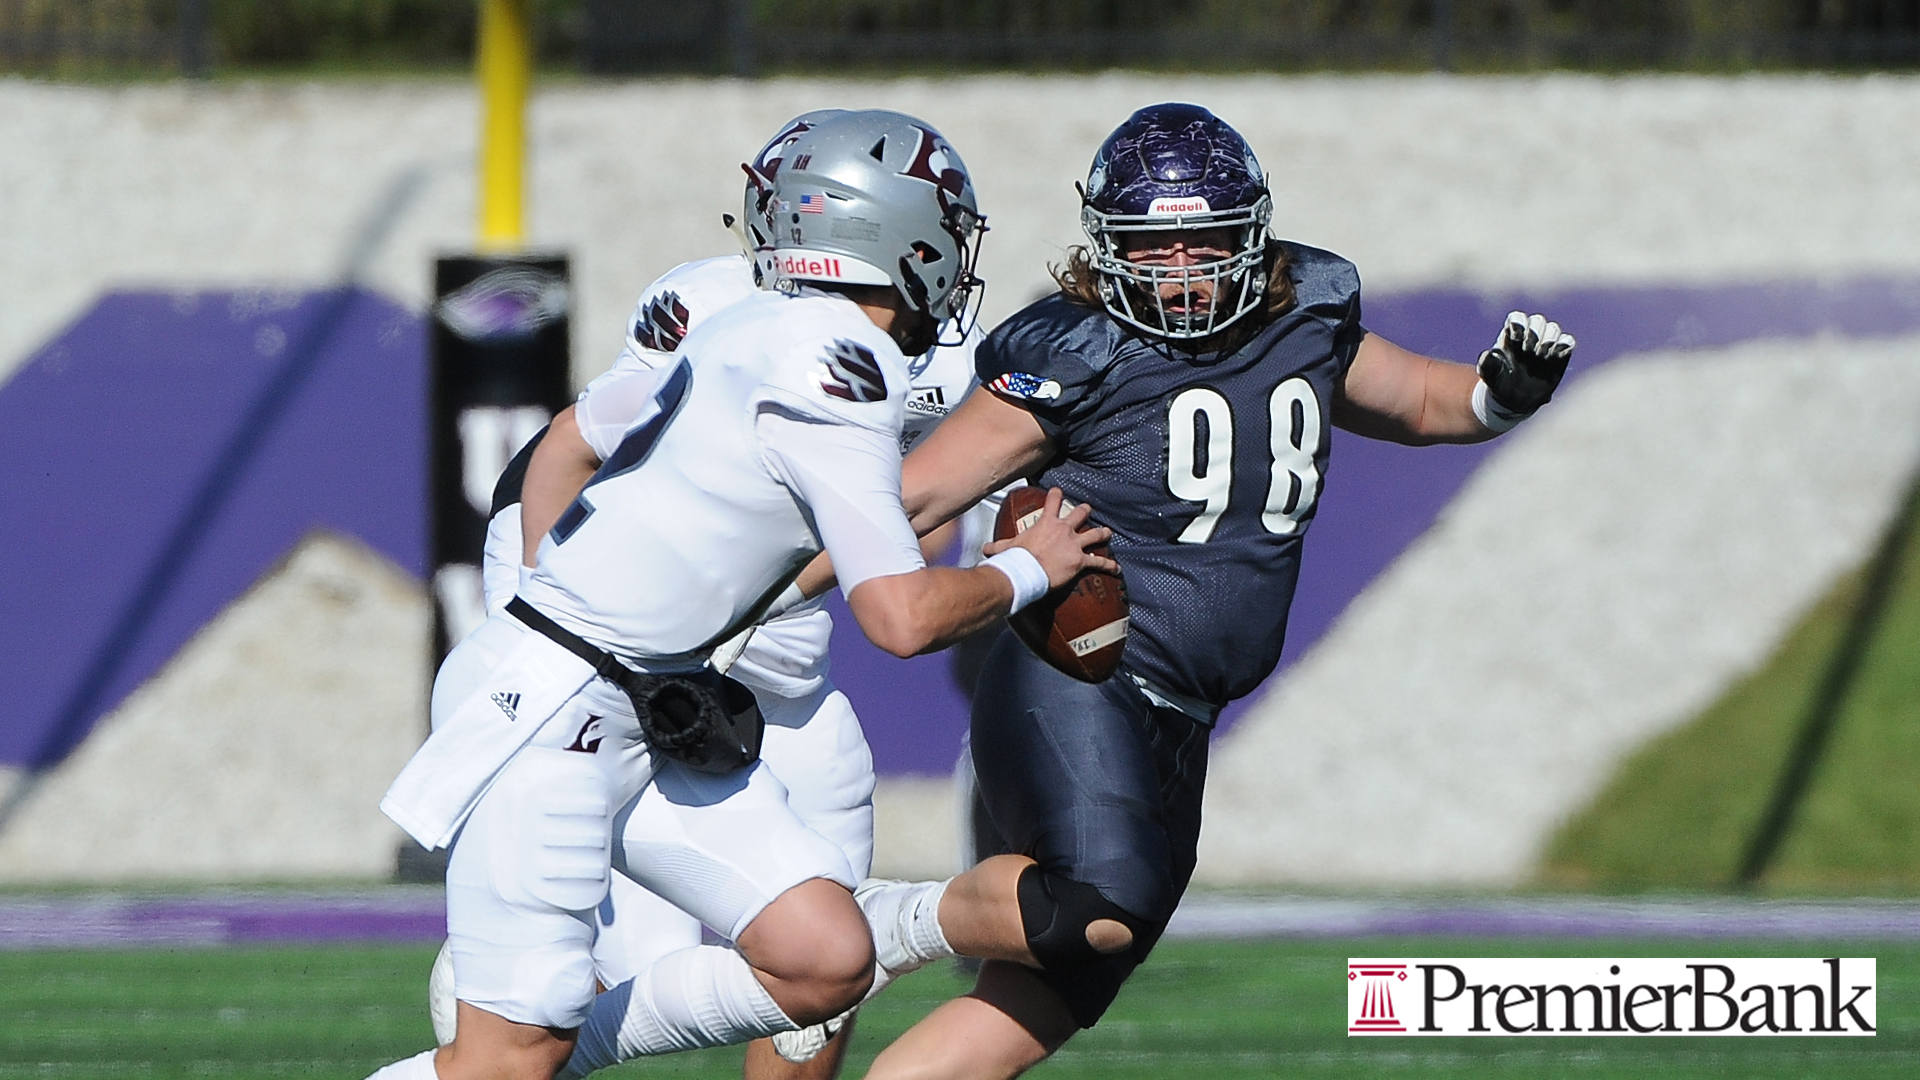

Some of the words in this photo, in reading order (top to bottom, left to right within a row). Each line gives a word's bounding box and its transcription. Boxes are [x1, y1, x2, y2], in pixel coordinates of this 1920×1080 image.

[1156, 202, 1203, 212] Riddell
[907, 400, 950, 416] adidas
[1167, 377, 1321, 544] 98
[490, 692, 518, 722] adidas
